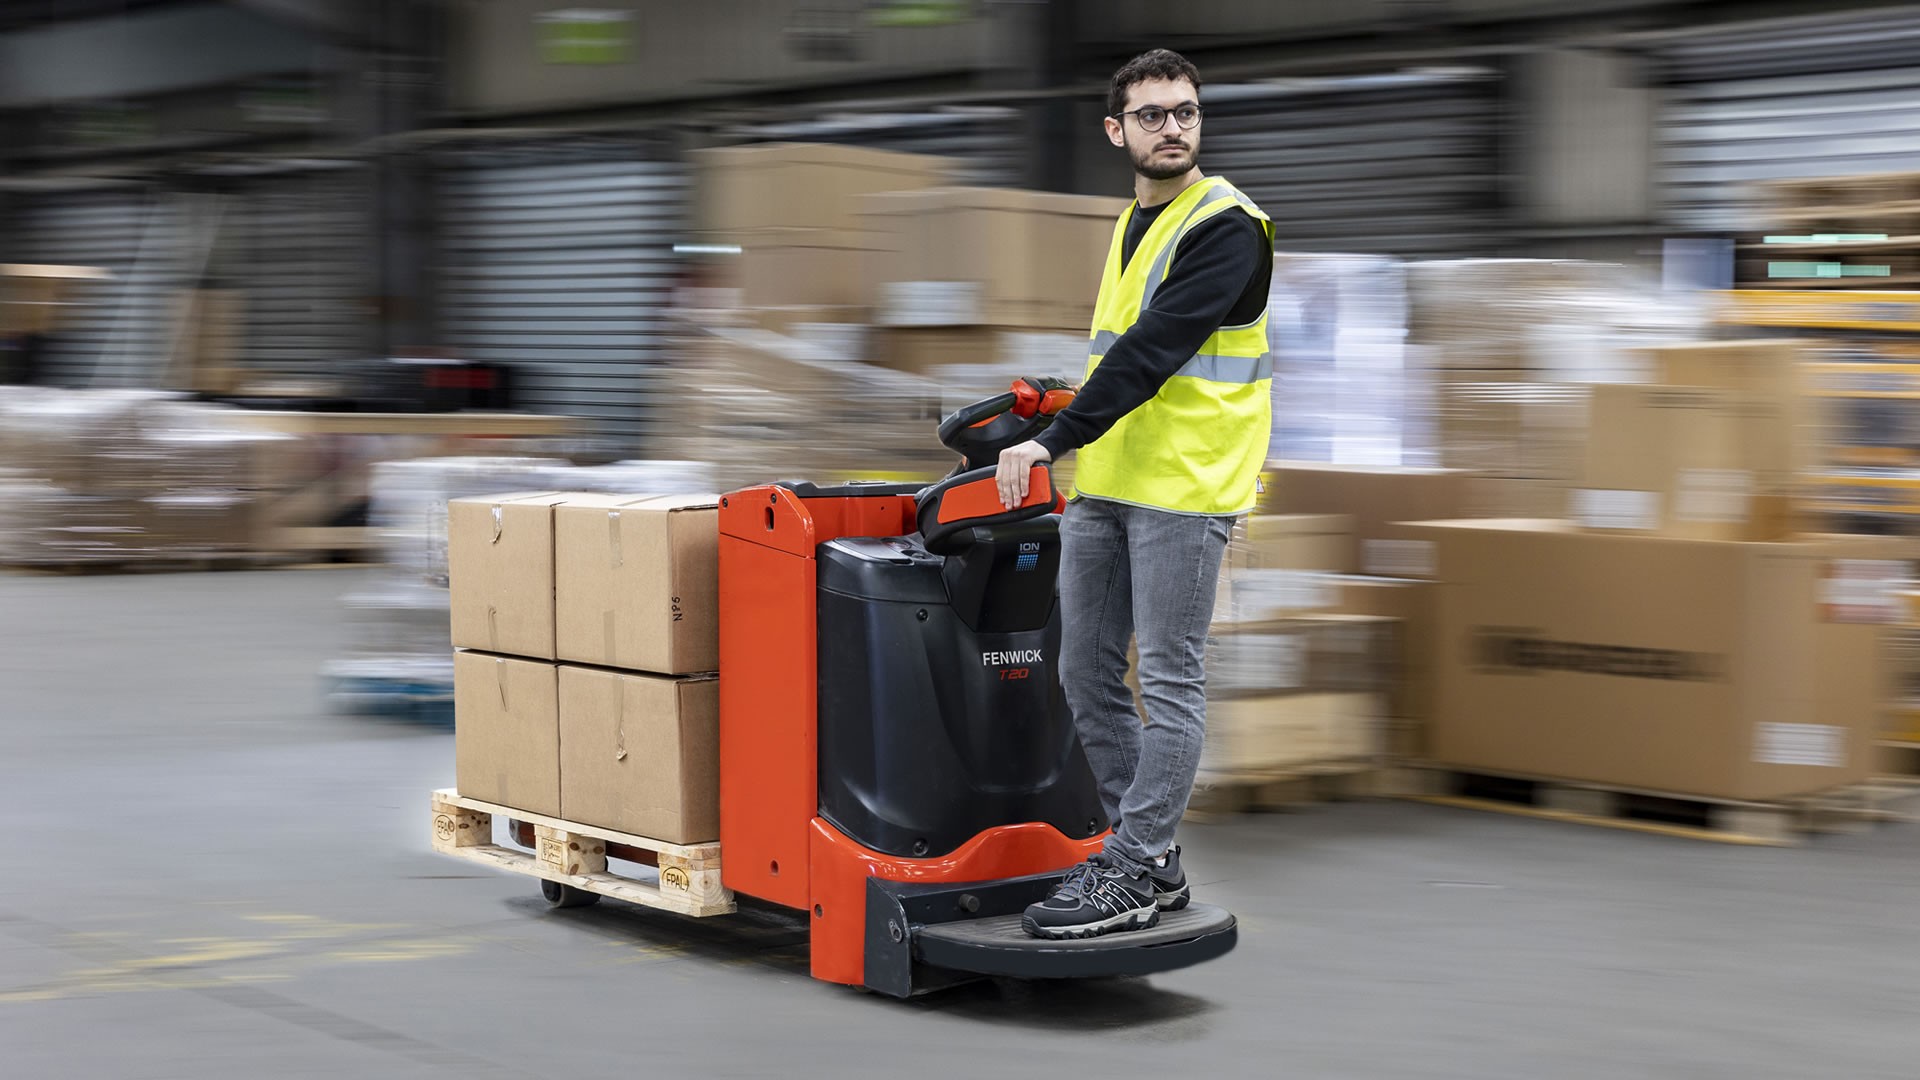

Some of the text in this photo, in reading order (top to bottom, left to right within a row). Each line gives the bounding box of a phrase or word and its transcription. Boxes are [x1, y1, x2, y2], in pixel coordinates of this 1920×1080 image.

[1019, 542, 1040, 551] ION
[982, 649, 1043, 666] FENWICK
[999, 668, 1029, 681] T20
